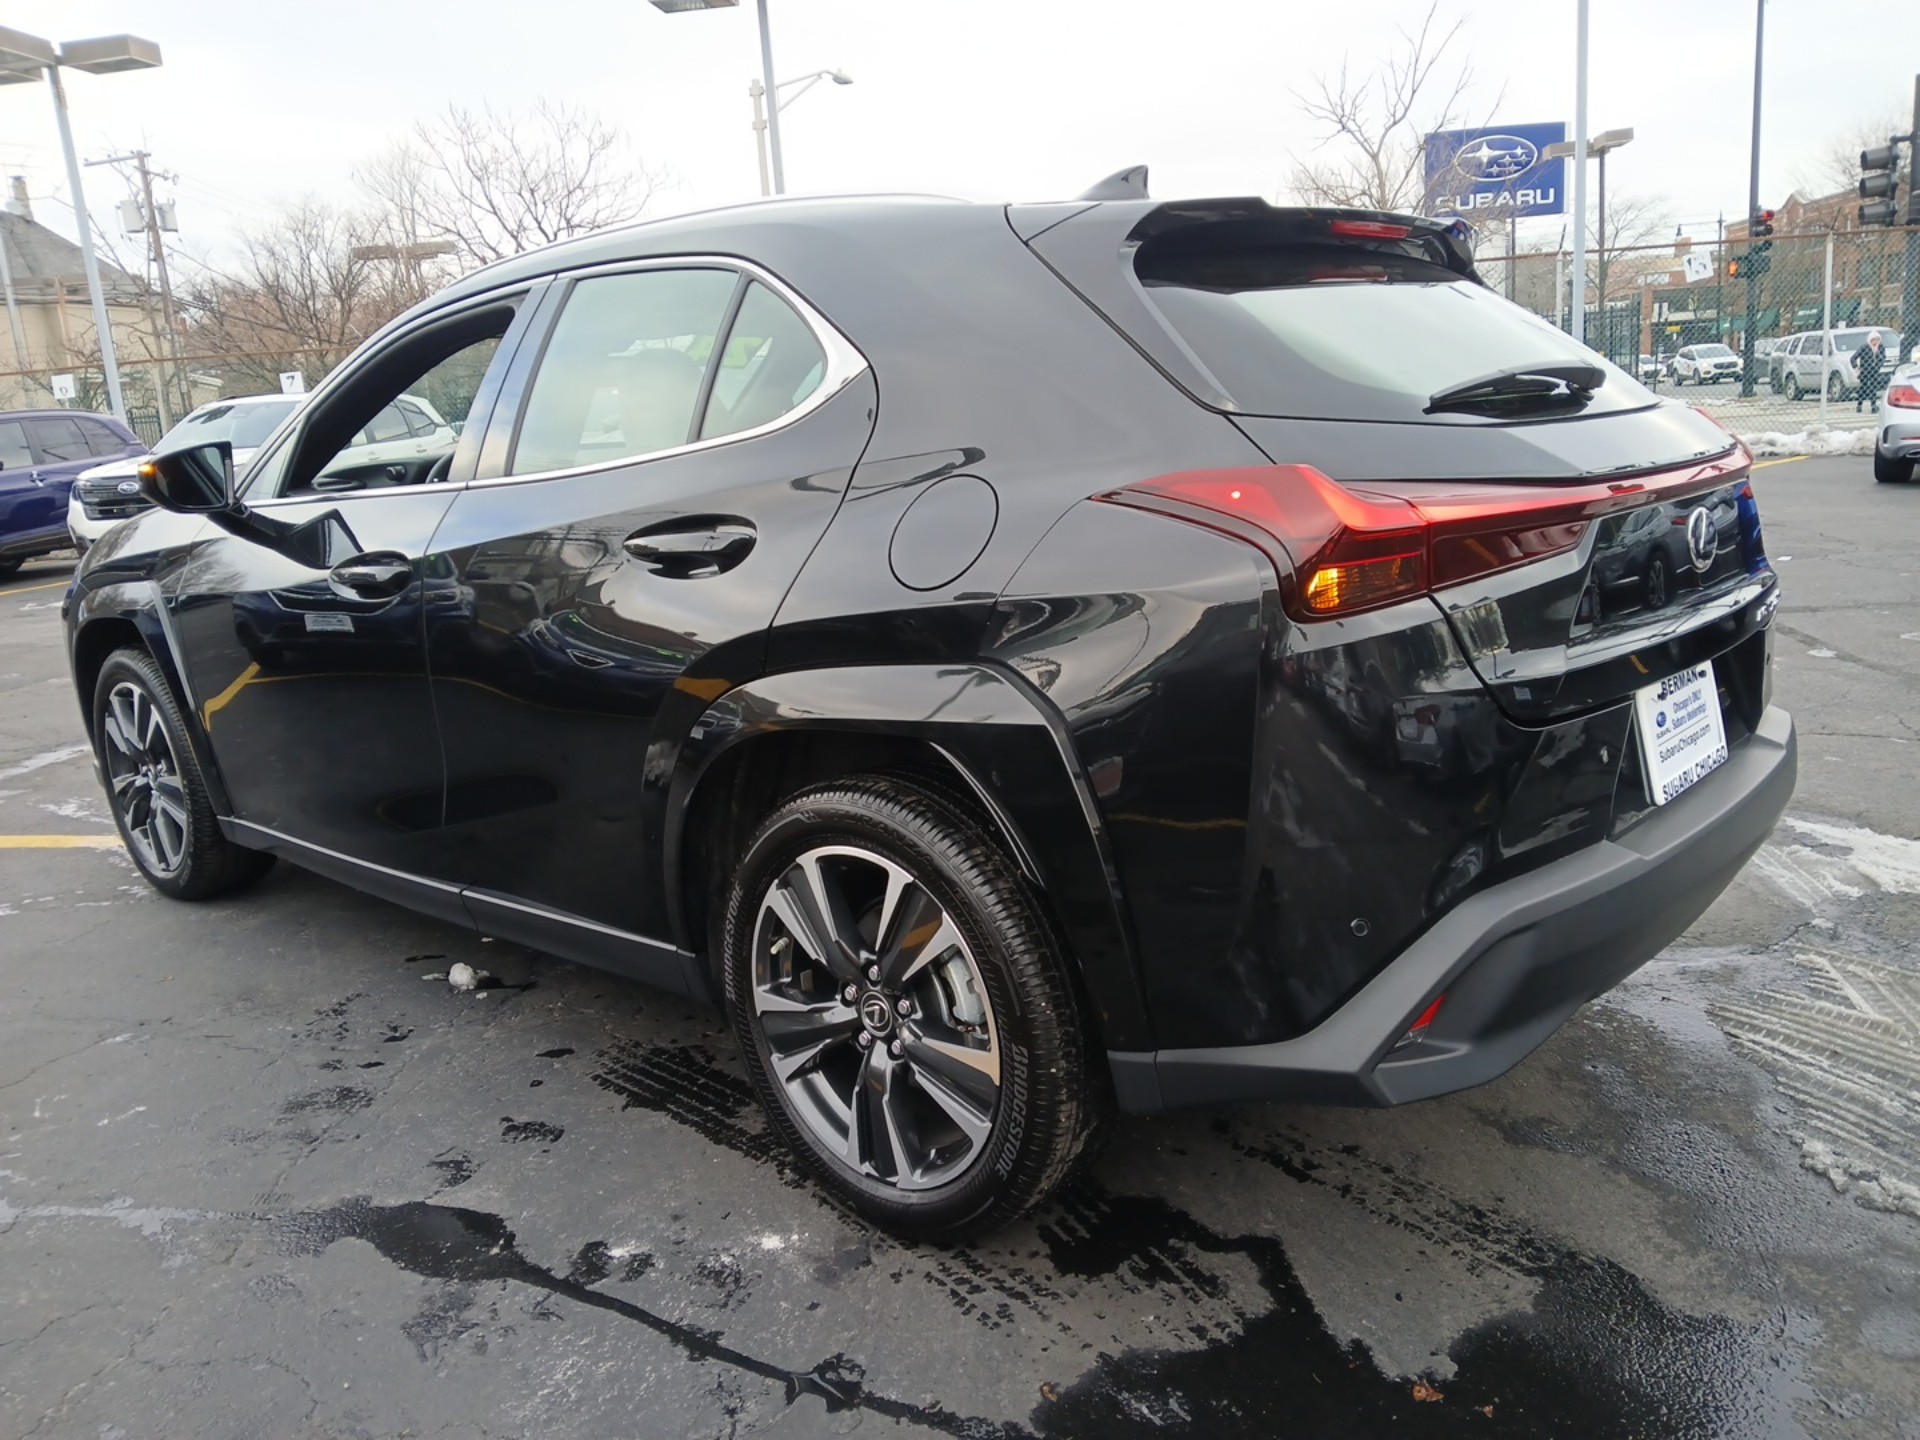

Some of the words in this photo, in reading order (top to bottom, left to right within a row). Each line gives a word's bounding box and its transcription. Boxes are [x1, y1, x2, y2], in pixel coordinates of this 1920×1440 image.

[1435, 187, 1555, 213] SUBARU
[1661, 667, 1698, 697] BERMAN
[1659, 724, 1711, 763] SubaruChicago.com
[1662, 766, 1694, 802] SUBARU
[1695, 744, 1726, 778] CHICAGO
[723, 880, 743, 1001] BRIDGESTONE
[994, 1042, 1029, 1181] BRIDGESTONE
